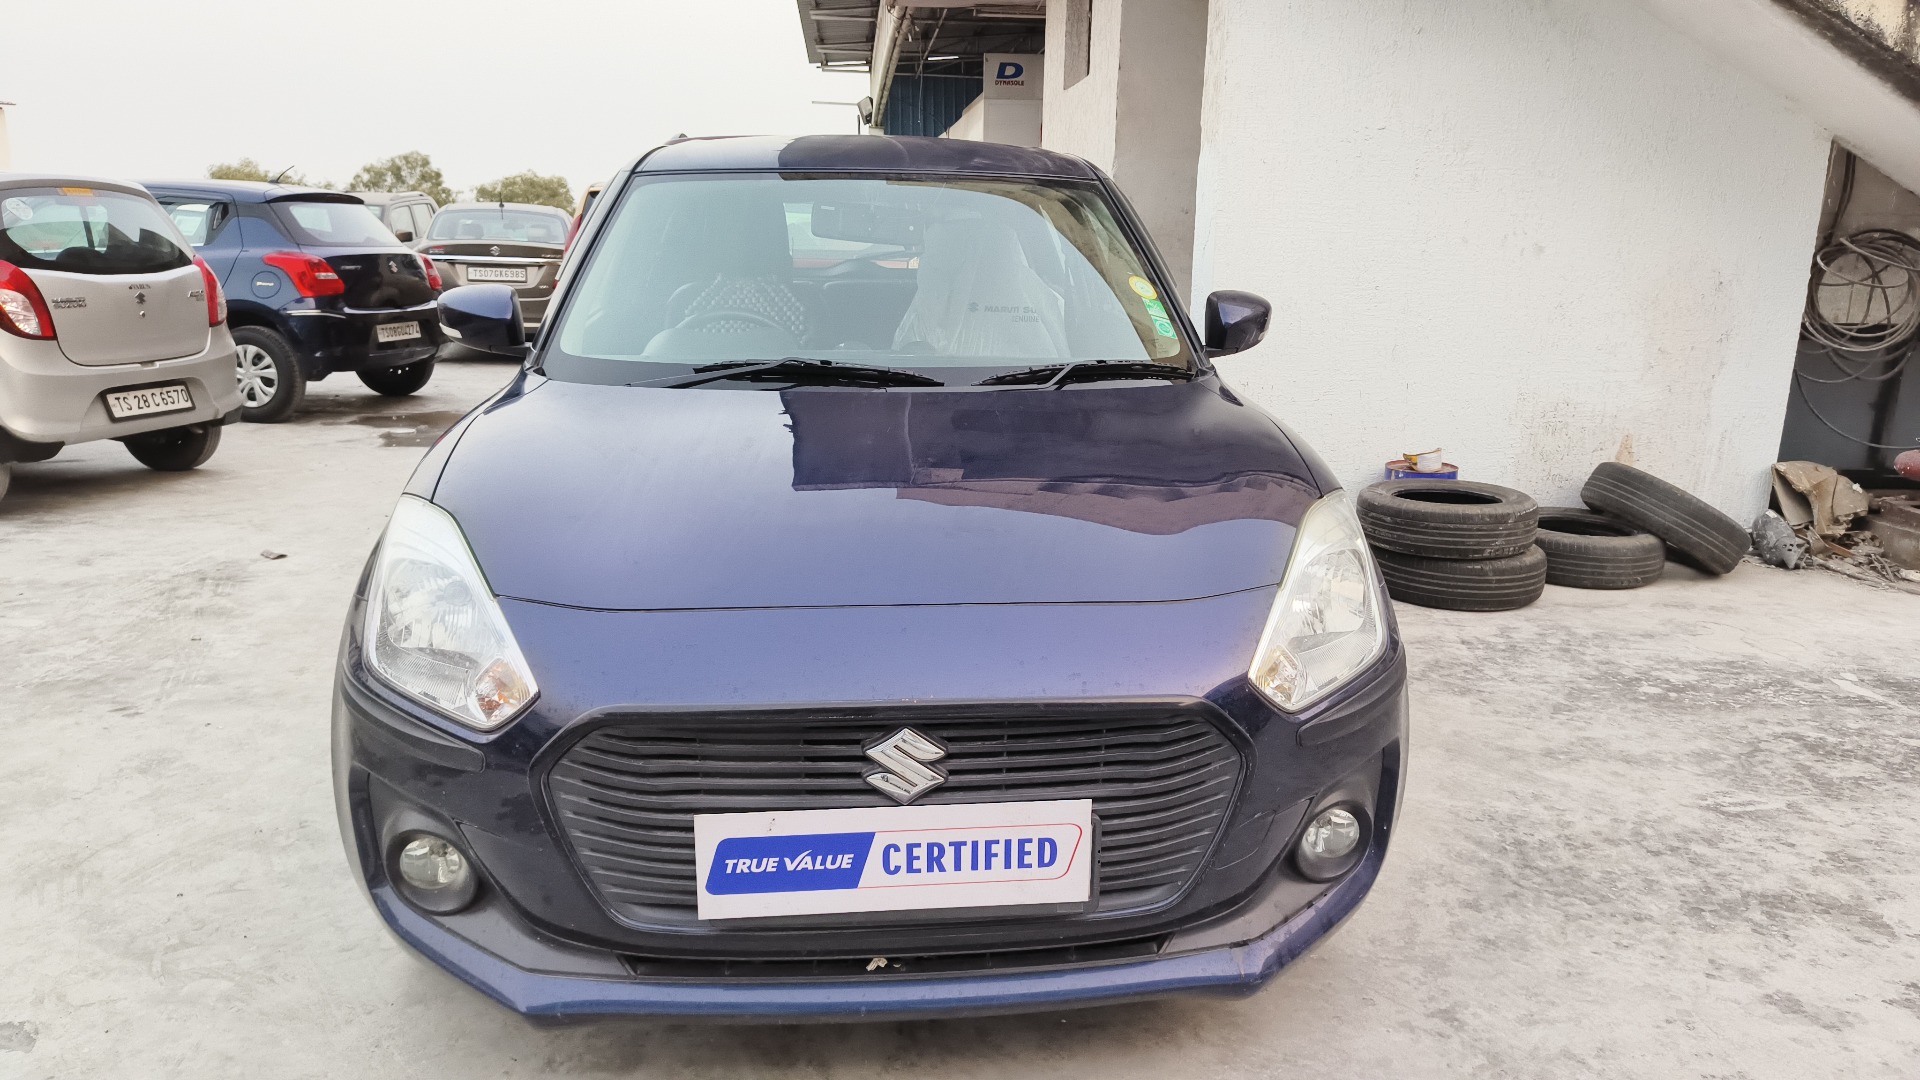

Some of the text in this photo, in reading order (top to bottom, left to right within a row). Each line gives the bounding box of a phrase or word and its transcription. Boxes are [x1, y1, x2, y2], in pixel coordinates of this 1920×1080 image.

[996, 62, 1024, 79] D
[115, 397, 133, 412] TS
[134, 394, 151, 409] 28
[724, 837, 1058, 875] TRUE VALUE CERTIFIED
